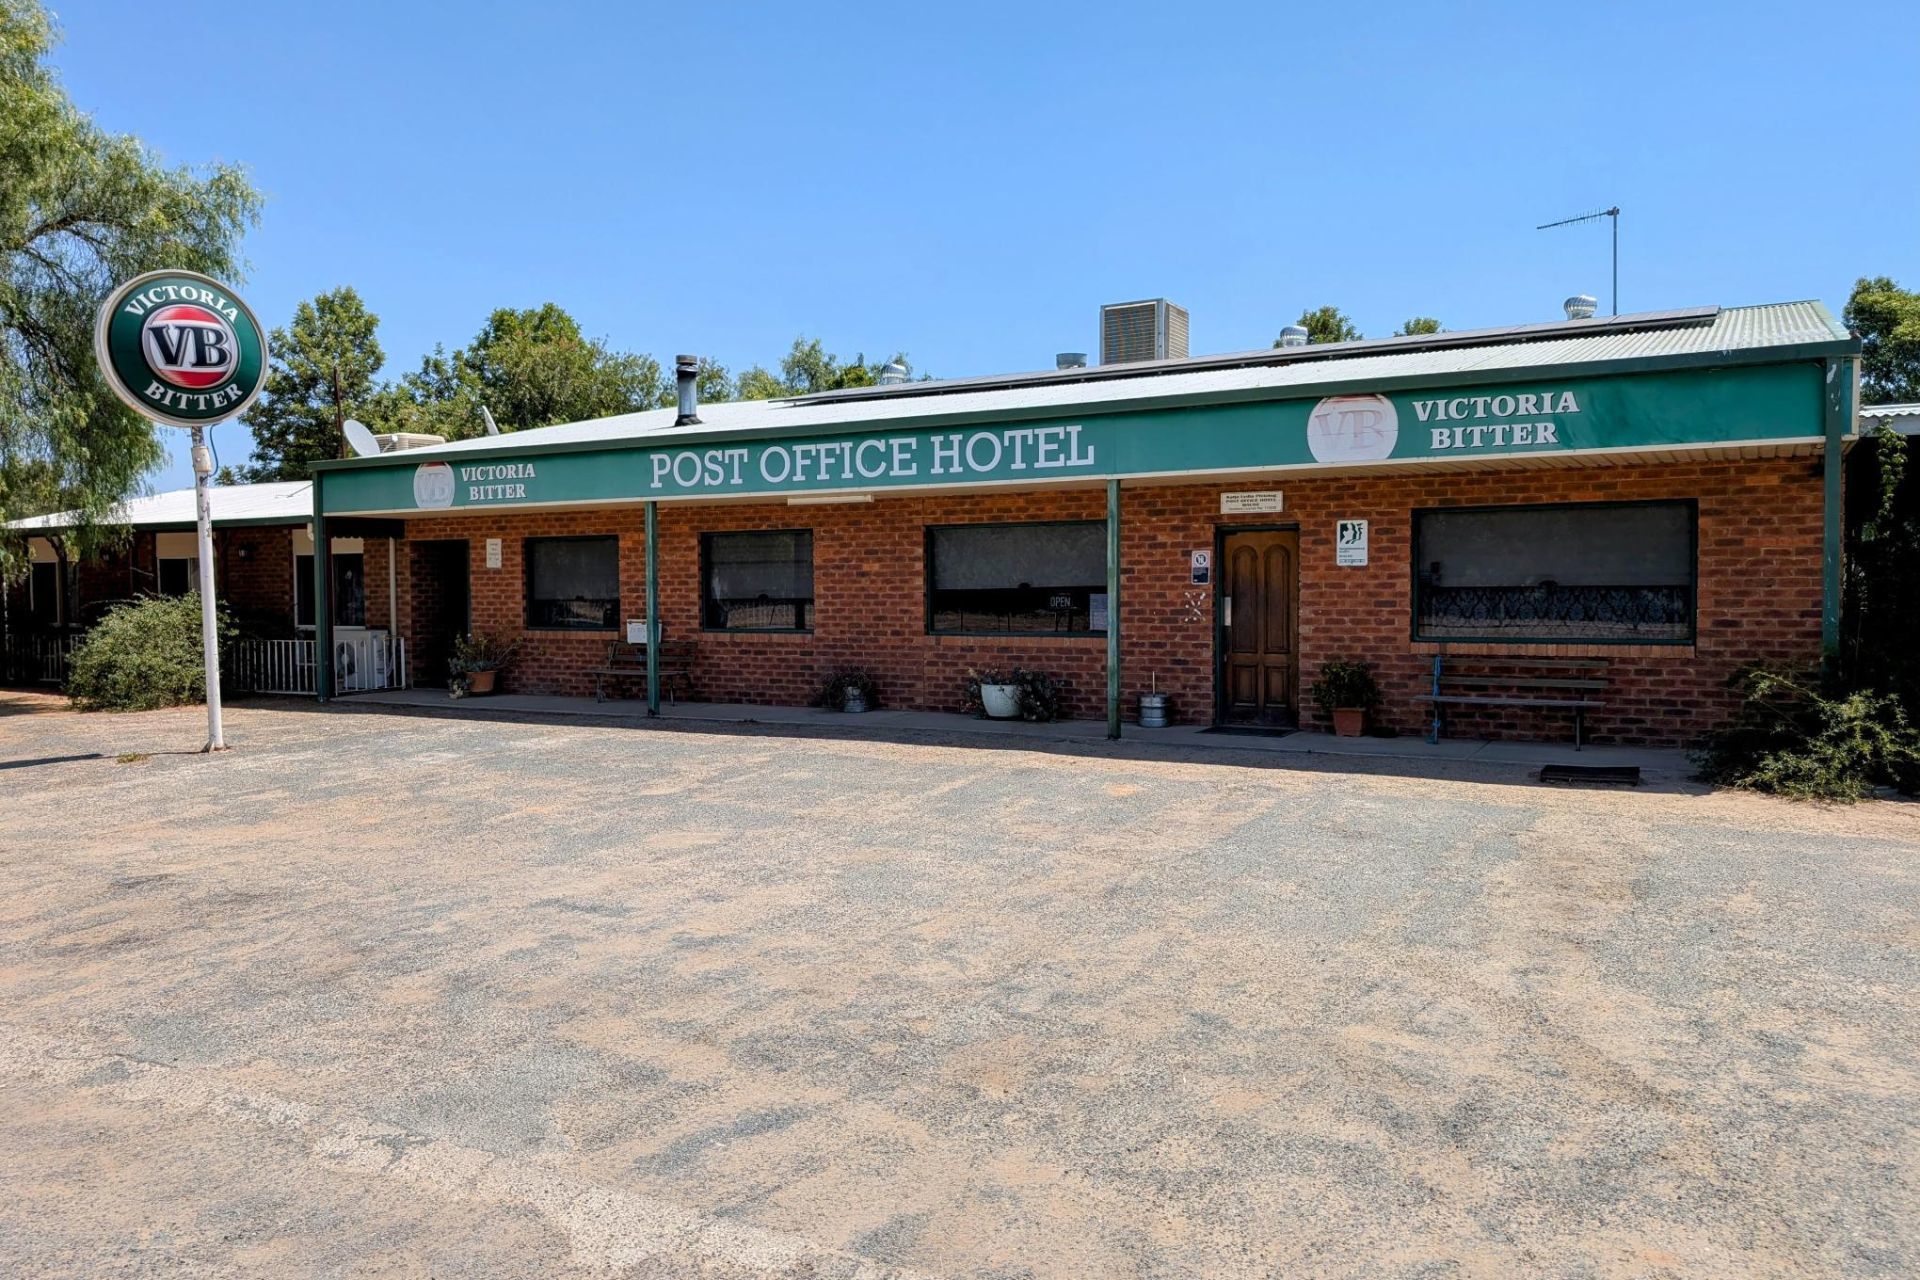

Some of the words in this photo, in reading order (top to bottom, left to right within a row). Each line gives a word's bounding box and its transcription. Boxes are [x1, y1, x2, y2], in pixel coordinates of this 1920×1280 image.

[124, 285, 239, 323] VICTORIA
[148, 325, 232, 368] VB
[144, 380, 243, 410] BITTER
[1413, 391, 1580, 422] VICTORIA
[1430, 423, 1558, 449] BITTER
[650, 449, 748, 488] POST
[760, 437, 917, 483] OFFICE
[930, 425, 1094, 474] HOTEL
[461, 464, 536, 482] VICTORIA
[469, 484, 526, 501] BITTER
[1050, 596, 1071, 607] OPEN
